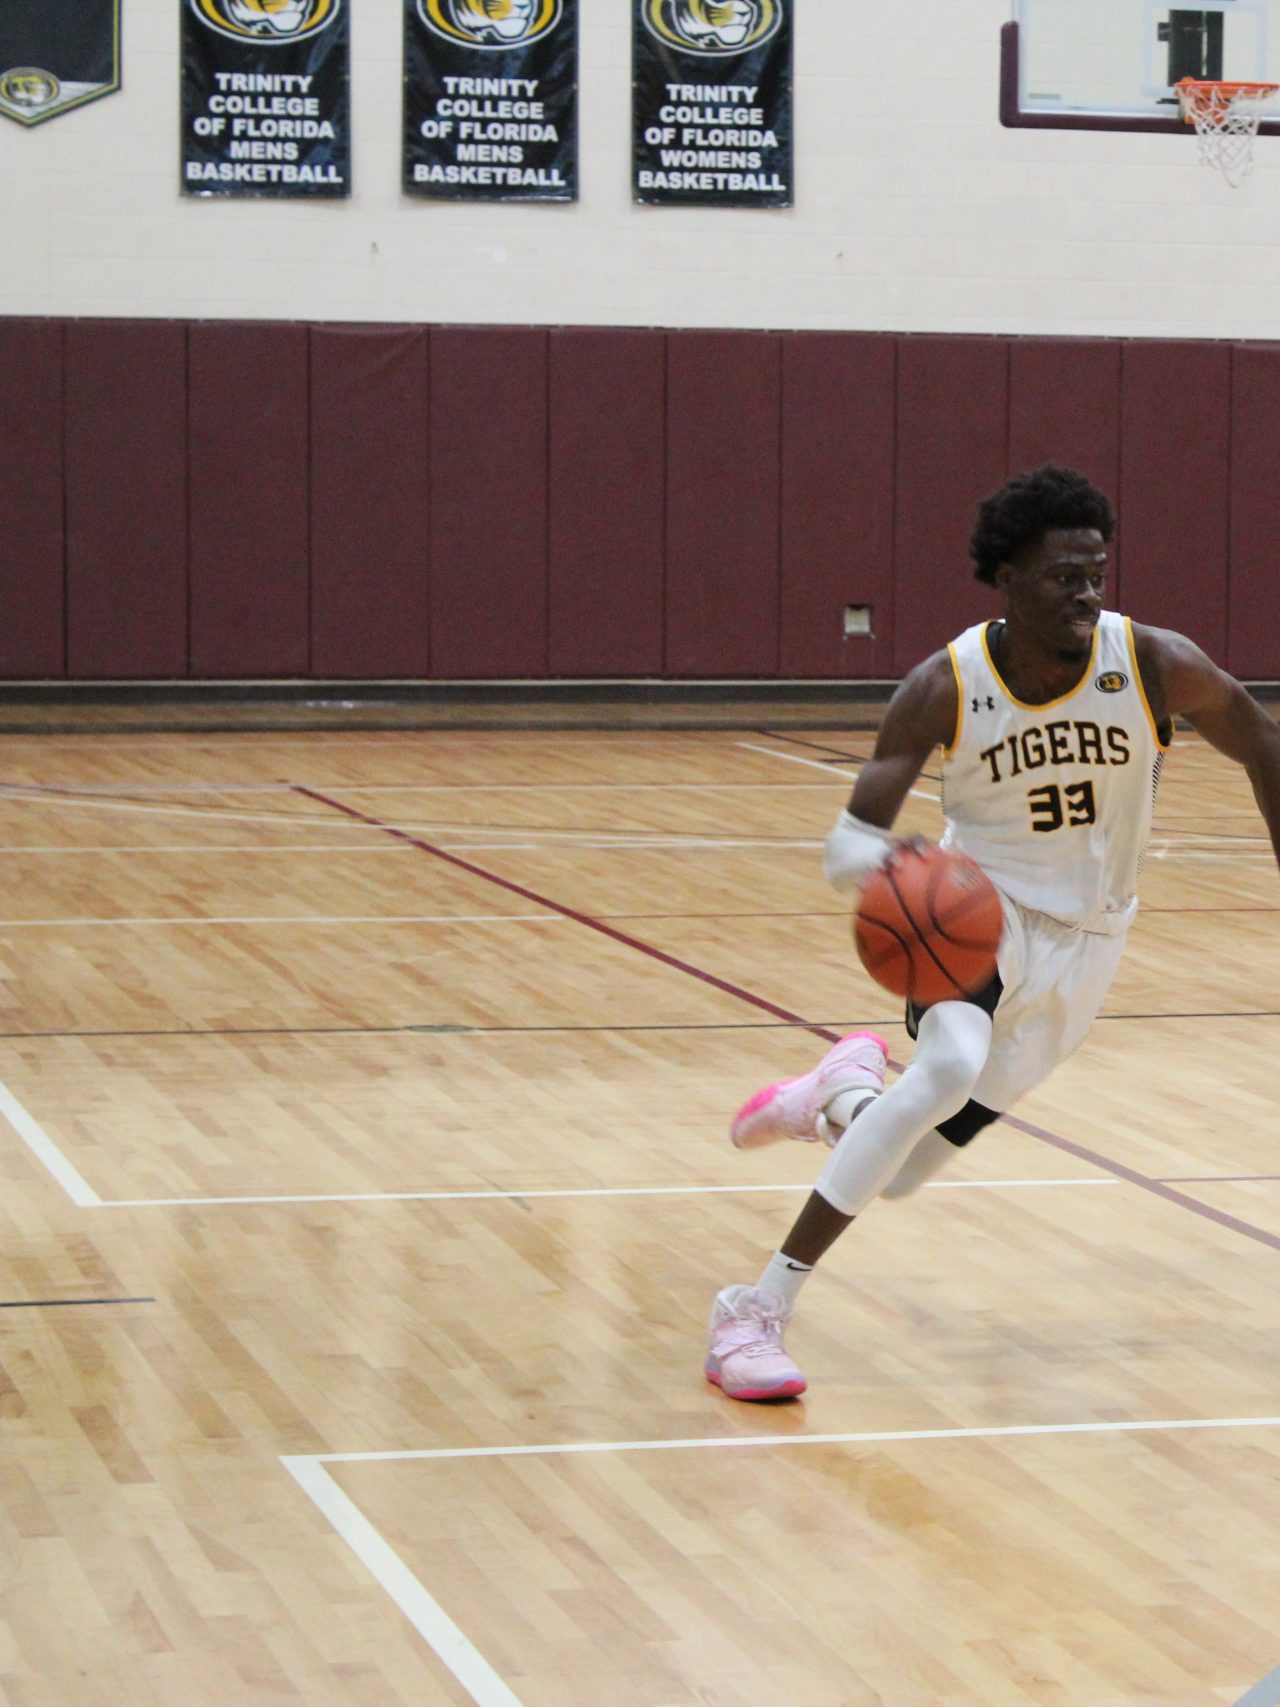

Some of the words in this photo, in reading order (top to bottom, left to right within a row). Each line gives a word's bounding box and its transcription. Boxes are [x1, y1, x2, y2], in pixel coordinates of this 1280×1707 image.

[215, 72, 313, 93] TRINITY
[443, 76, 539, 97] TRINITY
[665, 83, 758, 103] TRINITY
[208, 95, 320, 116] COLLEGE
[436, 98, 544, 120] COLLEGE
[659, 105, 764, 125] COLLEGE
[193, 117, 226, 136] OF
[232, 118, 335, 139] FLORIDA
[421, 120, 453, 138] OF
[459, 121, 558, 142] FLORIDA
[644, 127, 676, 145] OF
[682, 128, 778, 148] FLORIDA
[229, 140, 299, 160] MENS
[456, 143, 524, 163] MENS
[660, 150, 762, 169] WOMENS
[186, 161, 343, 183] BASKETBALL
[413, 164, 566, 186] BASKETBALL
[638, 170, 786, 191] BASKETBALL
[980, 720, 1130, 783] TIGERS
[1027, 780, 1096, 832] 33
